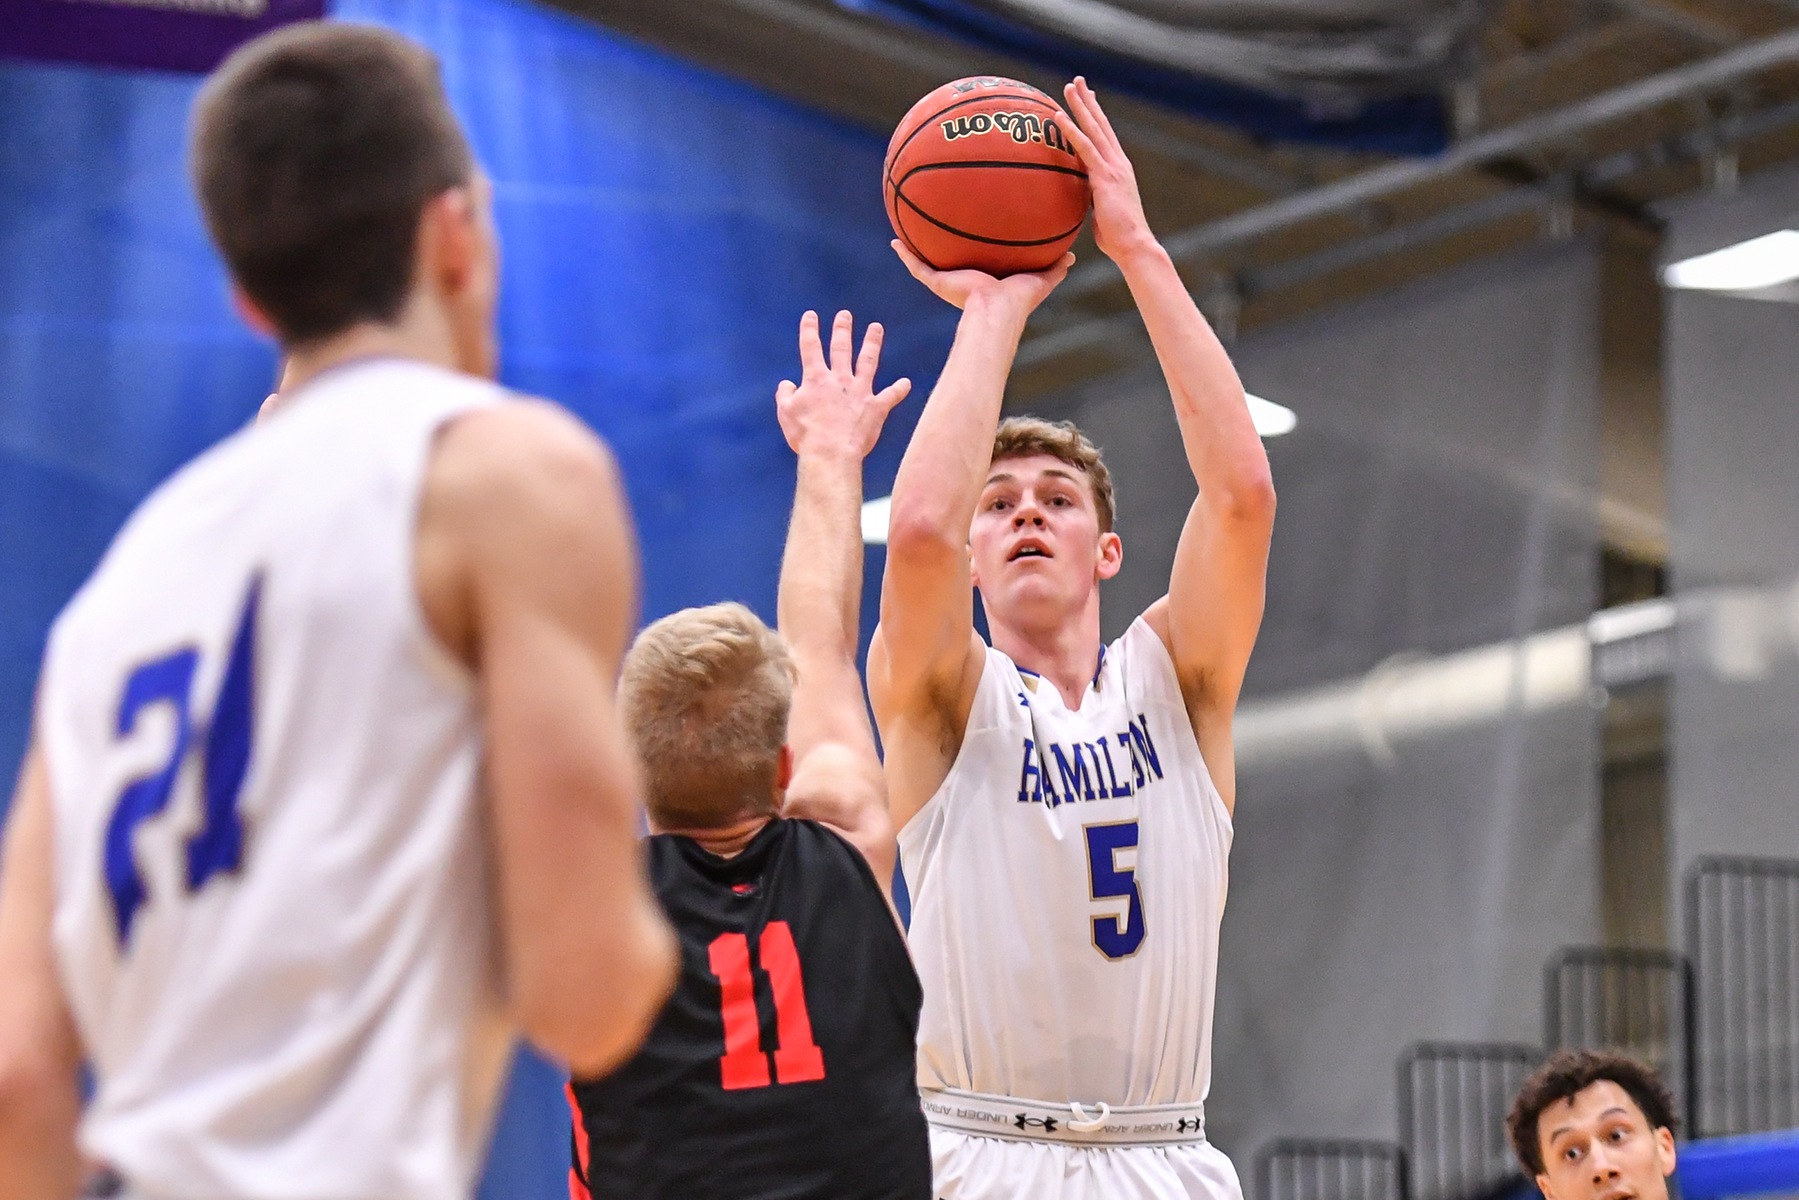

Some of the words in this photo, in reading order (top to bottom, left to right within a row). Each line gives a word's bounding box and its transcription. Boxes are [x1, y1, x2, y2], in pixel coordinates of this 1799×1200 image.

[101, 565, 264, 958] 21
[1082, 817, 1148, 962] 5
[708, 920, 826, 1090] 11
